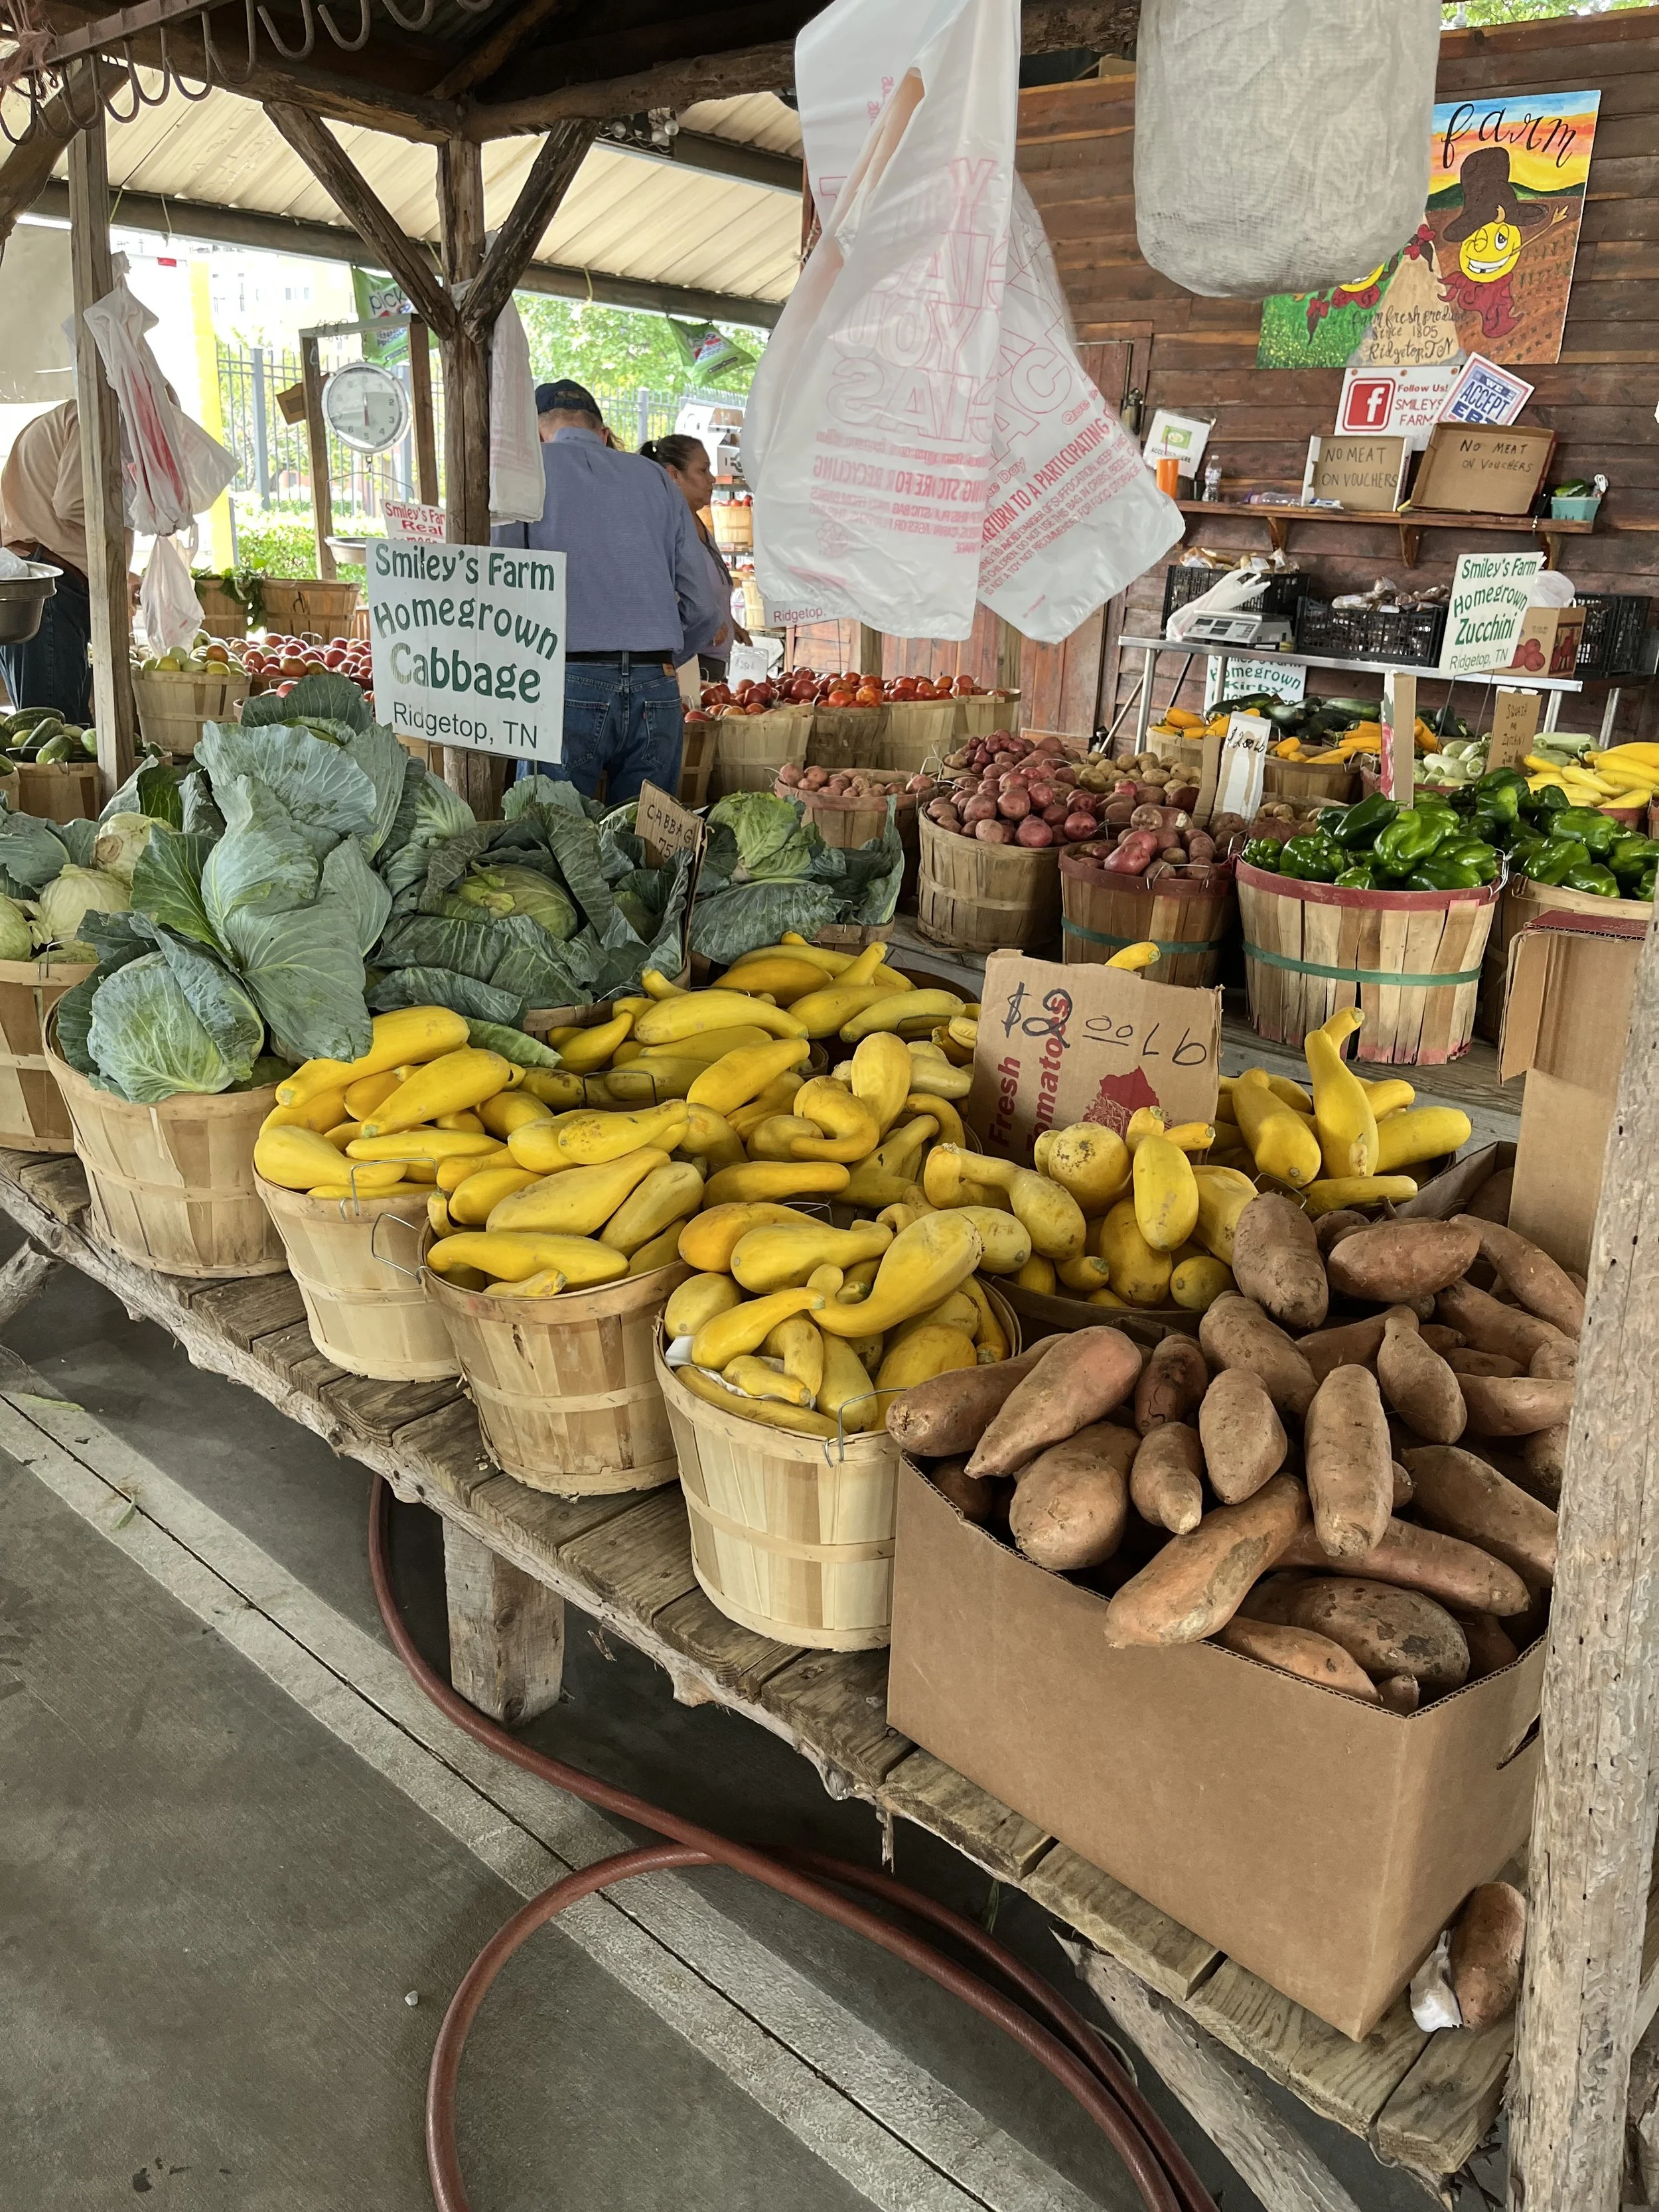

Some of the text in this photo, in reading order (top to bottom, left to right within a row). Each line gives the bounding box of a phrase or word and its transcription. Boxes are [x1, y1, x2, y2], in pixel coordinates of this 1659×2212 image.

[1441, 104, 1577, 169] farm
[369, 287, 406, 315] pick
[1386, 305, 1420, 328] fresh
[1372, 325, 1439, 340] since 1805
[1485, 378, 1504, 392] WE
[1063, 398, 1091, 425] Que
[1460, 381, 1510, 420] ACCEPT
[1033, 417, 1111, 489] PARTICIPATING
[1325, 447, 1386, 464] NO MEAT
[1492, 443, 1528, 455] MEAT
[997, 457, 1027, 485] Day
[1462, 458, 1534, 473] ON VOUCHERS
[1025, 481, 1042, 498] A
[1321, 473, 1399, 488] ON VOUCHERS
[1009, 488, 1033, 511] TO
[385, 502, 445, 525] Smiley's Far
[1016, 539, 1029, 552] DO
[1025, 531, 1039, 543] NOT
[1039, 518, 1055, 533] USE
[1050, 507, 1068, 524] THIS
[1066, 496, 1083, 511] BAG
[1080, 488, 1090, 497] IN
[1020, 510, 1044, 534] DANGER
[1043, 502, 1053, 514] OF
[401, 520, 443, 536] Real
[375, 543, 555, 591] Smiley's Farm
[985, 586, 994, 596] IS
[991, 577, 1004, 590] NOT
[1019, 548, 1035, 564] NOT
[1461, 557, 1537, 579] Smiley's Farm
[1453, 584, 1528, 618] Homegrown
[374, 597, 558, 660] Homegrown
[774, 607, 826, 623] Ridgetop,
[1455, 612, 1518, 645] Zucchini
[390, 642, 541, 703] Cabbage
[1449, 648, 1508, 670] Ridgetop, TN
[1224, 681, 1284, 694] Kirby
[394, 701, 538, 749] Ridgetop, TN
[988, 1057, 1021, 1148] Fresh
